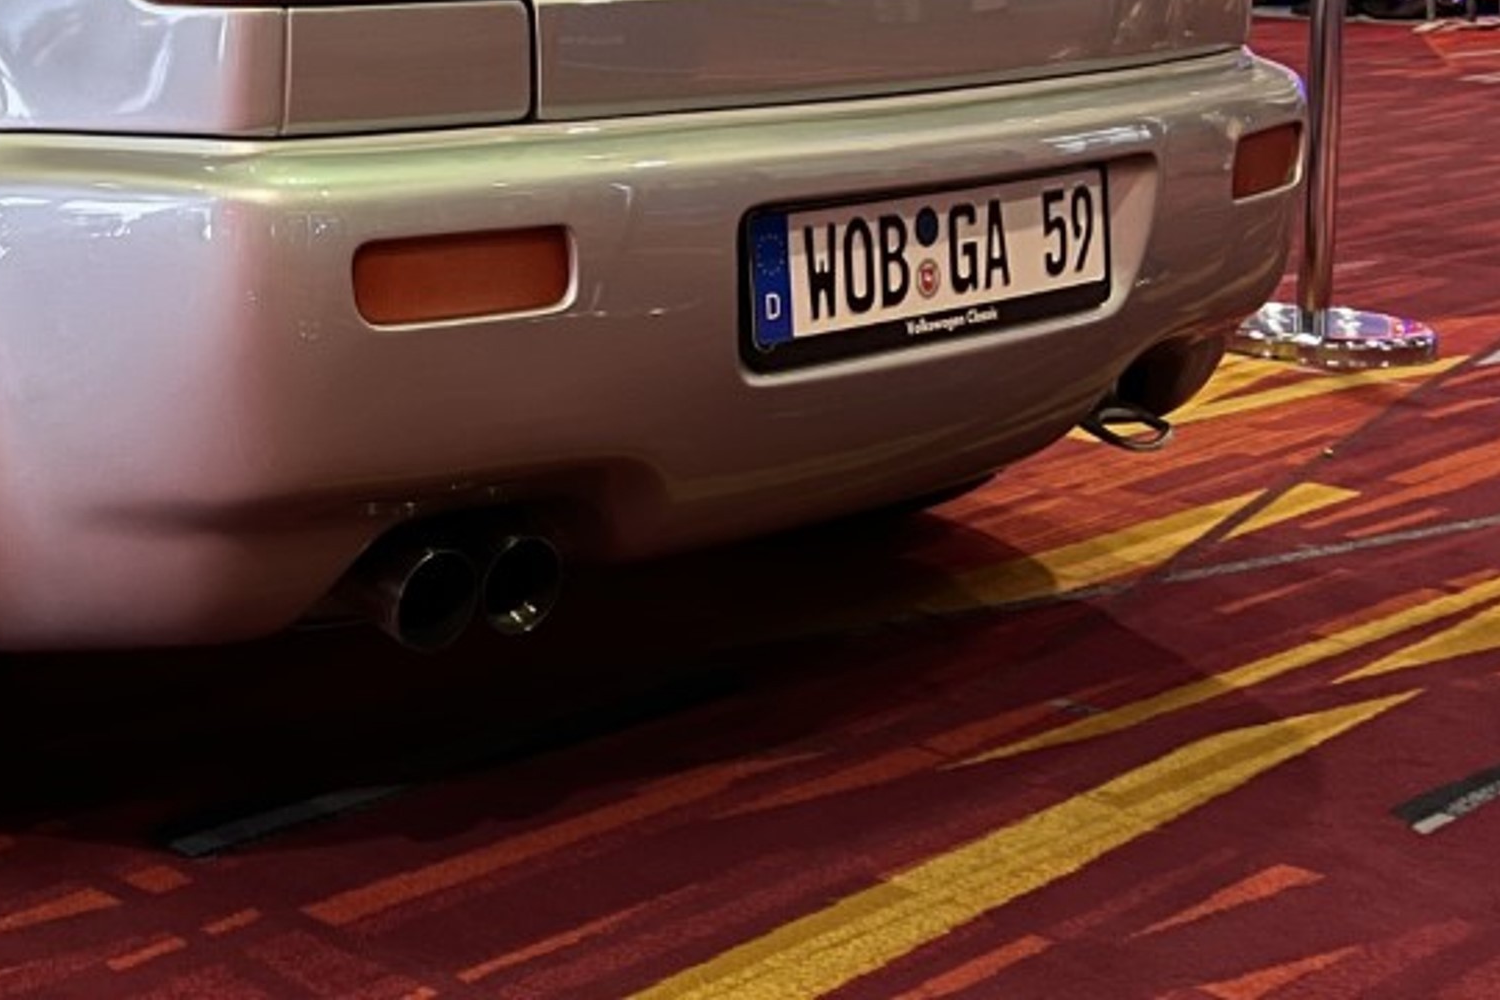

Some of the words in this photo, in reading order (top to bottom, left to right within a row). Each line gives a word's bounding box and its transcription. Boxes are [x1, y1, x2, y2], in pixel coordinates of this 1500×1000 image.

[803, 214, 912, 321] WOB
[948, 198, 1011, 295] GA
[1042, 183, 1094, 277] 59
[764, 292, 781, 320] D
